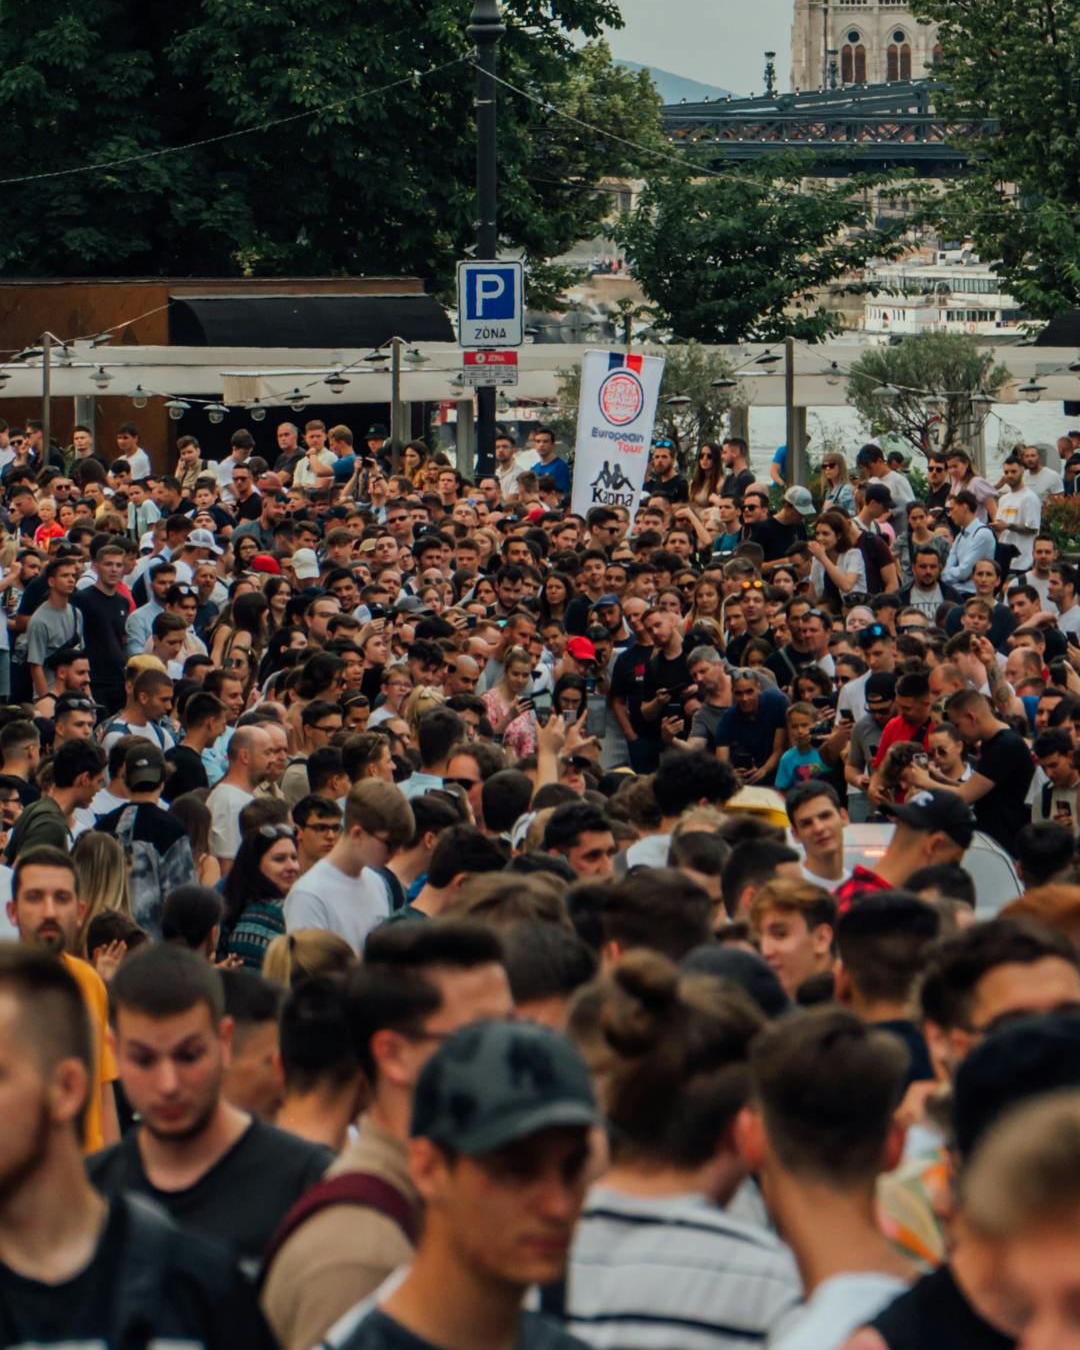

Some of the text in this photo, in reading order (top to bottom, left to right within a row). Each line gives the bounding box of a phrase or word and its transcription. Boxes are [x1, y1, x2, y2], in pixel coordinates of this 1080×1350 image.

[475, 273, 505, 317] P
[591, 426, 645, 443] European
[617, 440, 645, 454] Tour
